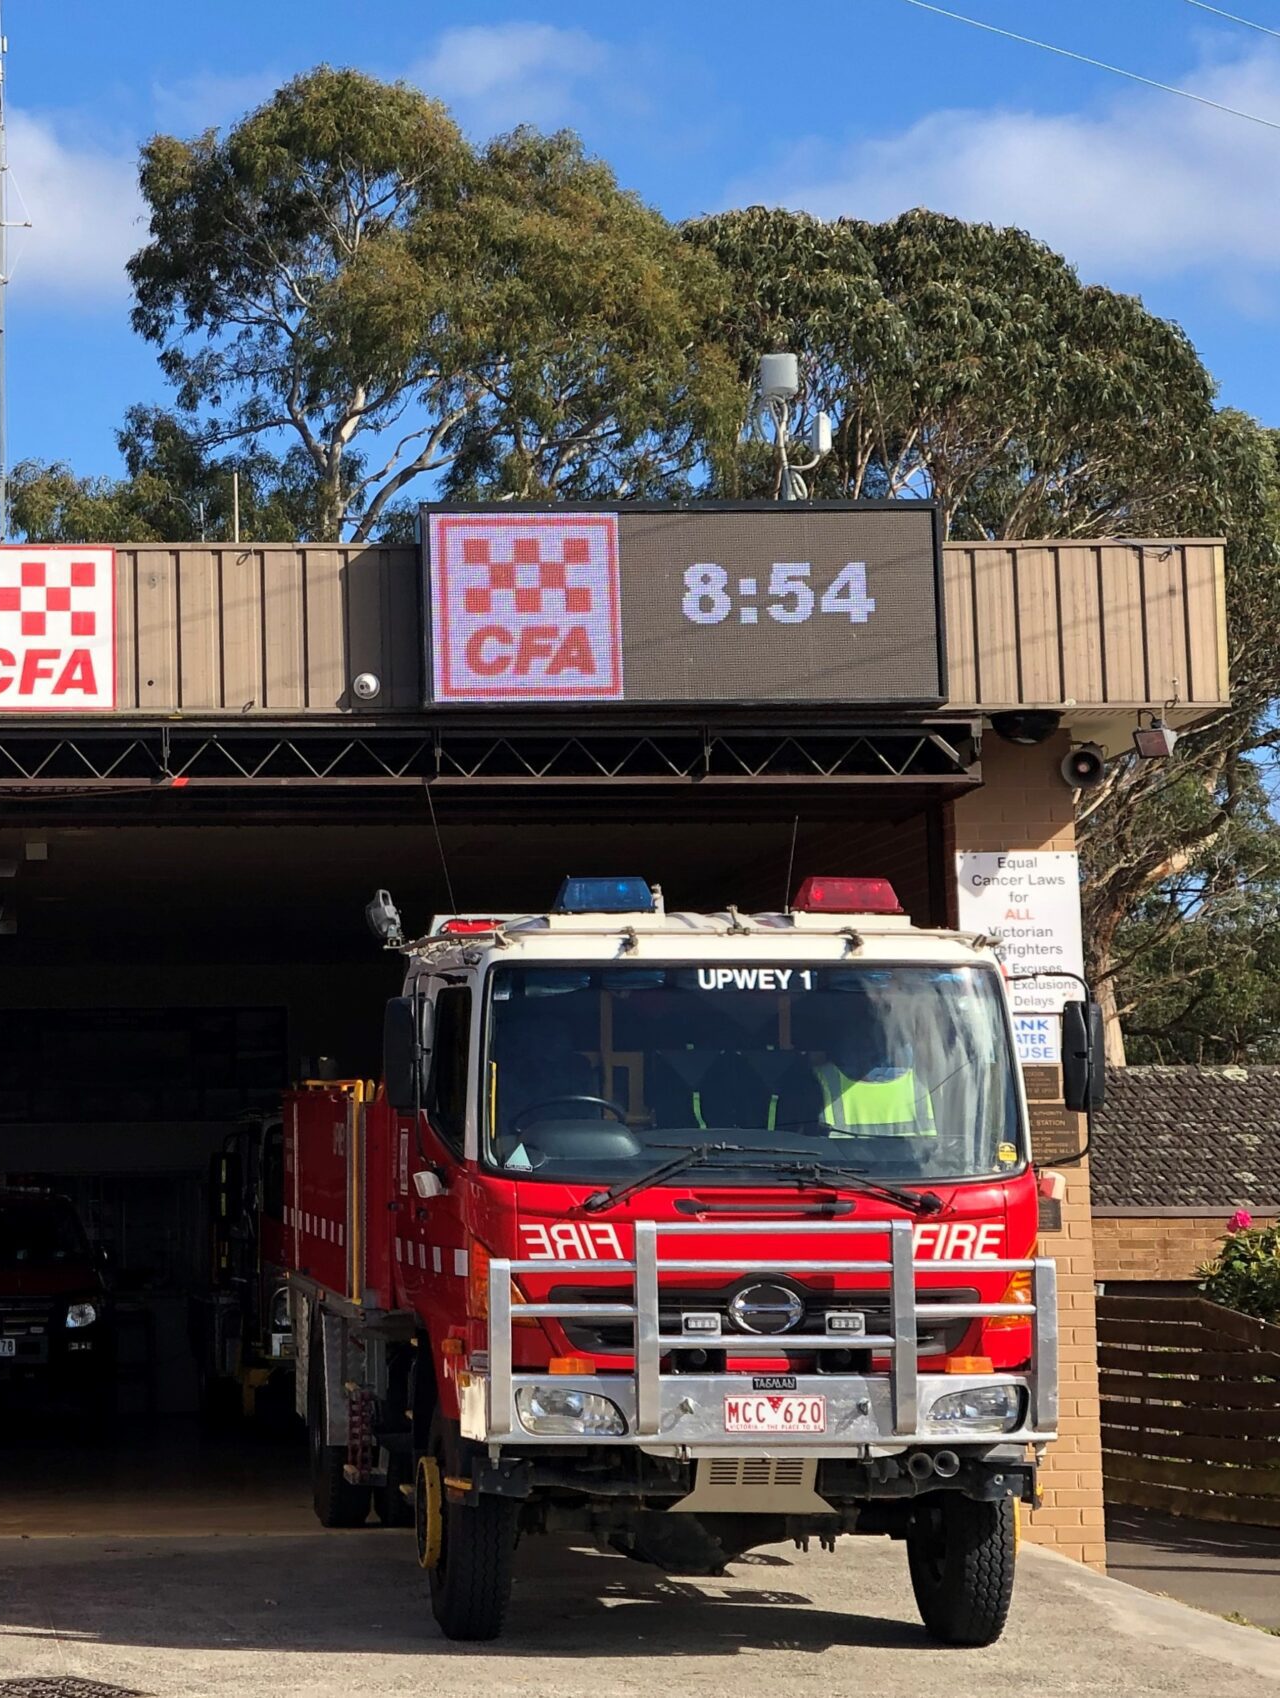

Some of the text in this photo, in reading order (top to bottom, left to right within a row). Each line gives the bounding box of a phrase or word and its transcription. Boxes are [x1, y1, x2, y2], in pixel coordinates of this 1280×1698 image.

[681, 562, 875, 624] 8:54
[465, 624, 597, 676] CFA
[997, 857, 1038, 870] Equal
[972, 874, 1066, 886] Cancer Laws
[1009, 891, 1029, 903] for
[1004, 908, 1035, 920] ALL
[988, 926, 1054, 938] Victorian
[993, 943, 1064, 958] efighters
[1012, 963, 1063, 974] Excuses
[698, 968, 811, 990] UPWEY 1
[1013, 980, 1078, 990] Exclusions
[1014, 996, 1055, 1008] Delays
[1014, 1019, 1049, 1031] NK
[1016, 1033, 1047, 1044] ATER
[913, 1224, 1005, 1260] FIRE
[753, 1378, 796, 1389] TASMAN
[728, 1402, 821, 1423] MCC 620
